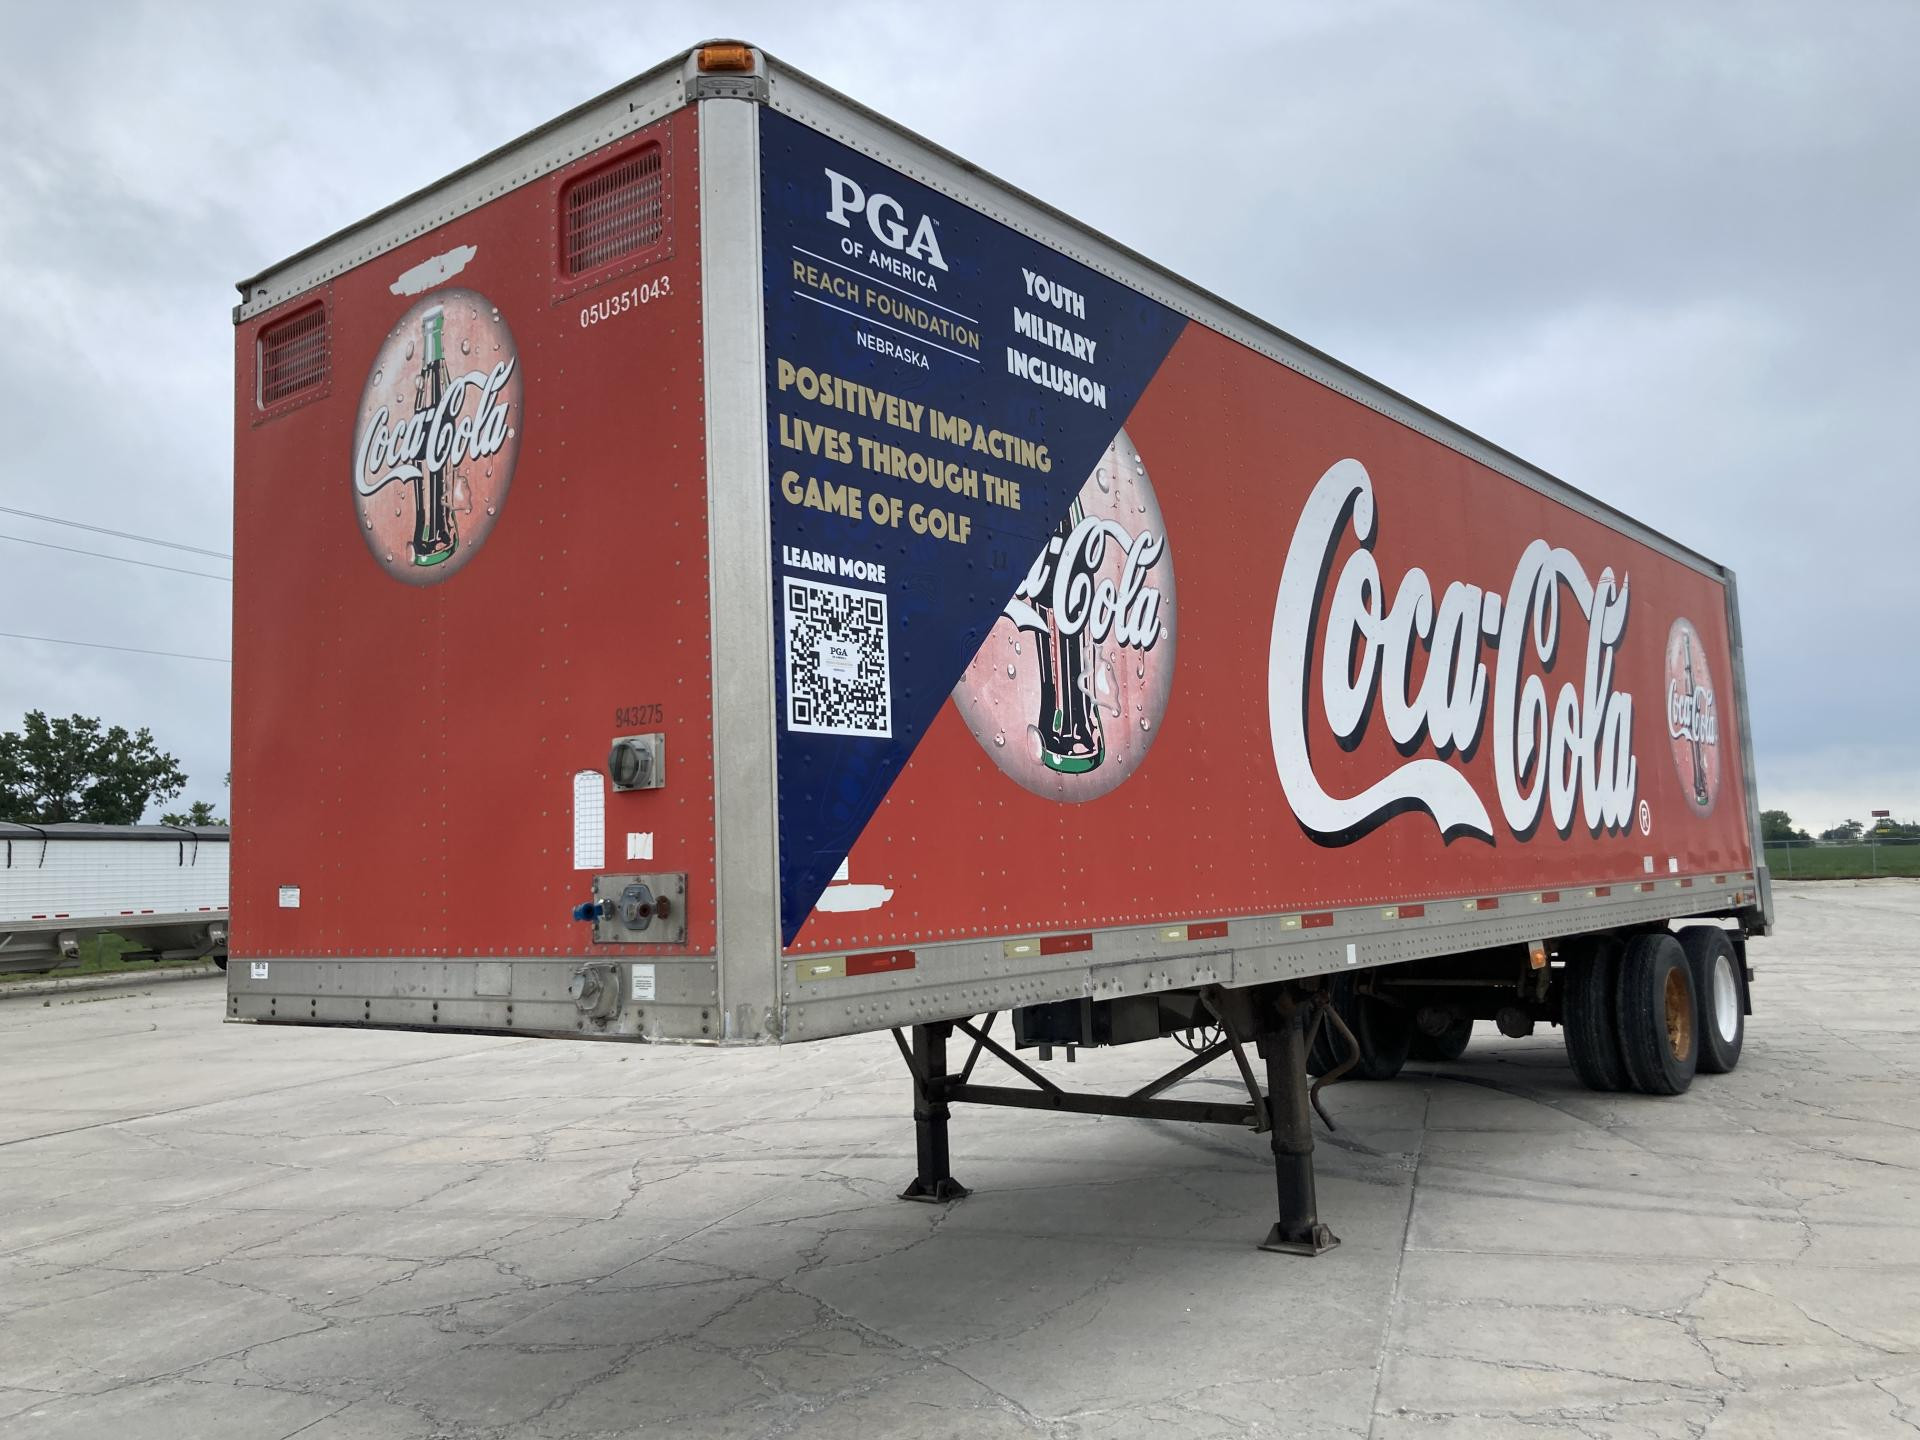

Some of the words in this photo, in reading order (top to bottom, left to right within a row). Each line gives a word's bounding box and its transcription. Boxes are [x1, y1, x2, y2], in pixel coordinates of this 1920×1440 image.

[824, 167, 949, 272] PGA
[840, 237, 864, 259] OF
[868, 251, 938, 293] AMERICA
[1021, 267, 1086, 321] YOUTH
[580, 275, 670, 328] 05U351043
[792, 259, 859, 304] REACH
[866, 288, 981, 352] FOUNDATION
[856, 330, 930, 371] NEBRASKA
[1012, 306, 1098, 365] MILITARY
[1006, 346, 1107, 410] INCLUSION
[776, 358, 926, 435] POSITIVELY
[929, 408, 1053, 474] IMPACTING
[779, 413, 854, 465] LIVES
[857, 437, 979, 501] THROUGH
[982, 474, 1022, 511] THE
[780, 470, 863, 521] GAME
[868, 492, 904, 530] OF
[908, 503, 972, 545] GOLF
[782, 545, 837, 575] LEARN
[839, 555, 886, 584] MORE
[829, 646, 849, 657] PGA
